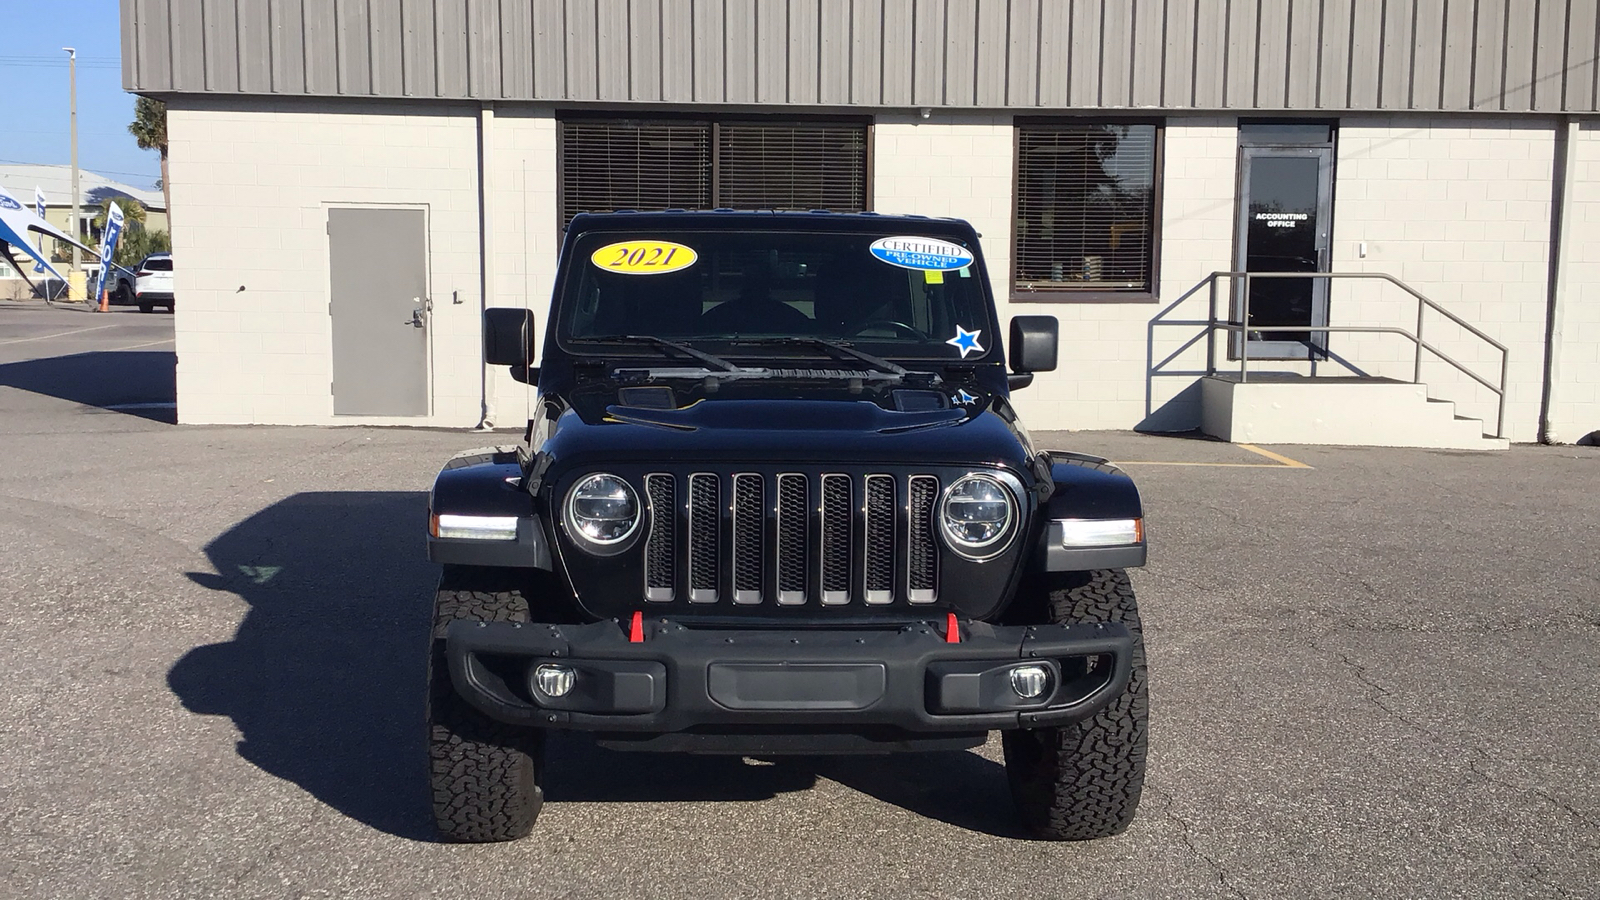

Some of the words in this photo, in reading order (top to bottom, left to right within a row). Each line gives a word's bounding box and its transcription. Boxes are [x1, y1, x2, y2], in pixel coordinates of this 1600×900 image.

[882, 240, 962, 257] CERTIFIED
[609, 247, 678, 267] 2021
[886, 250, 958, 264] PRE-OWNED
[896, 257, 948, 268] VEHICLE
